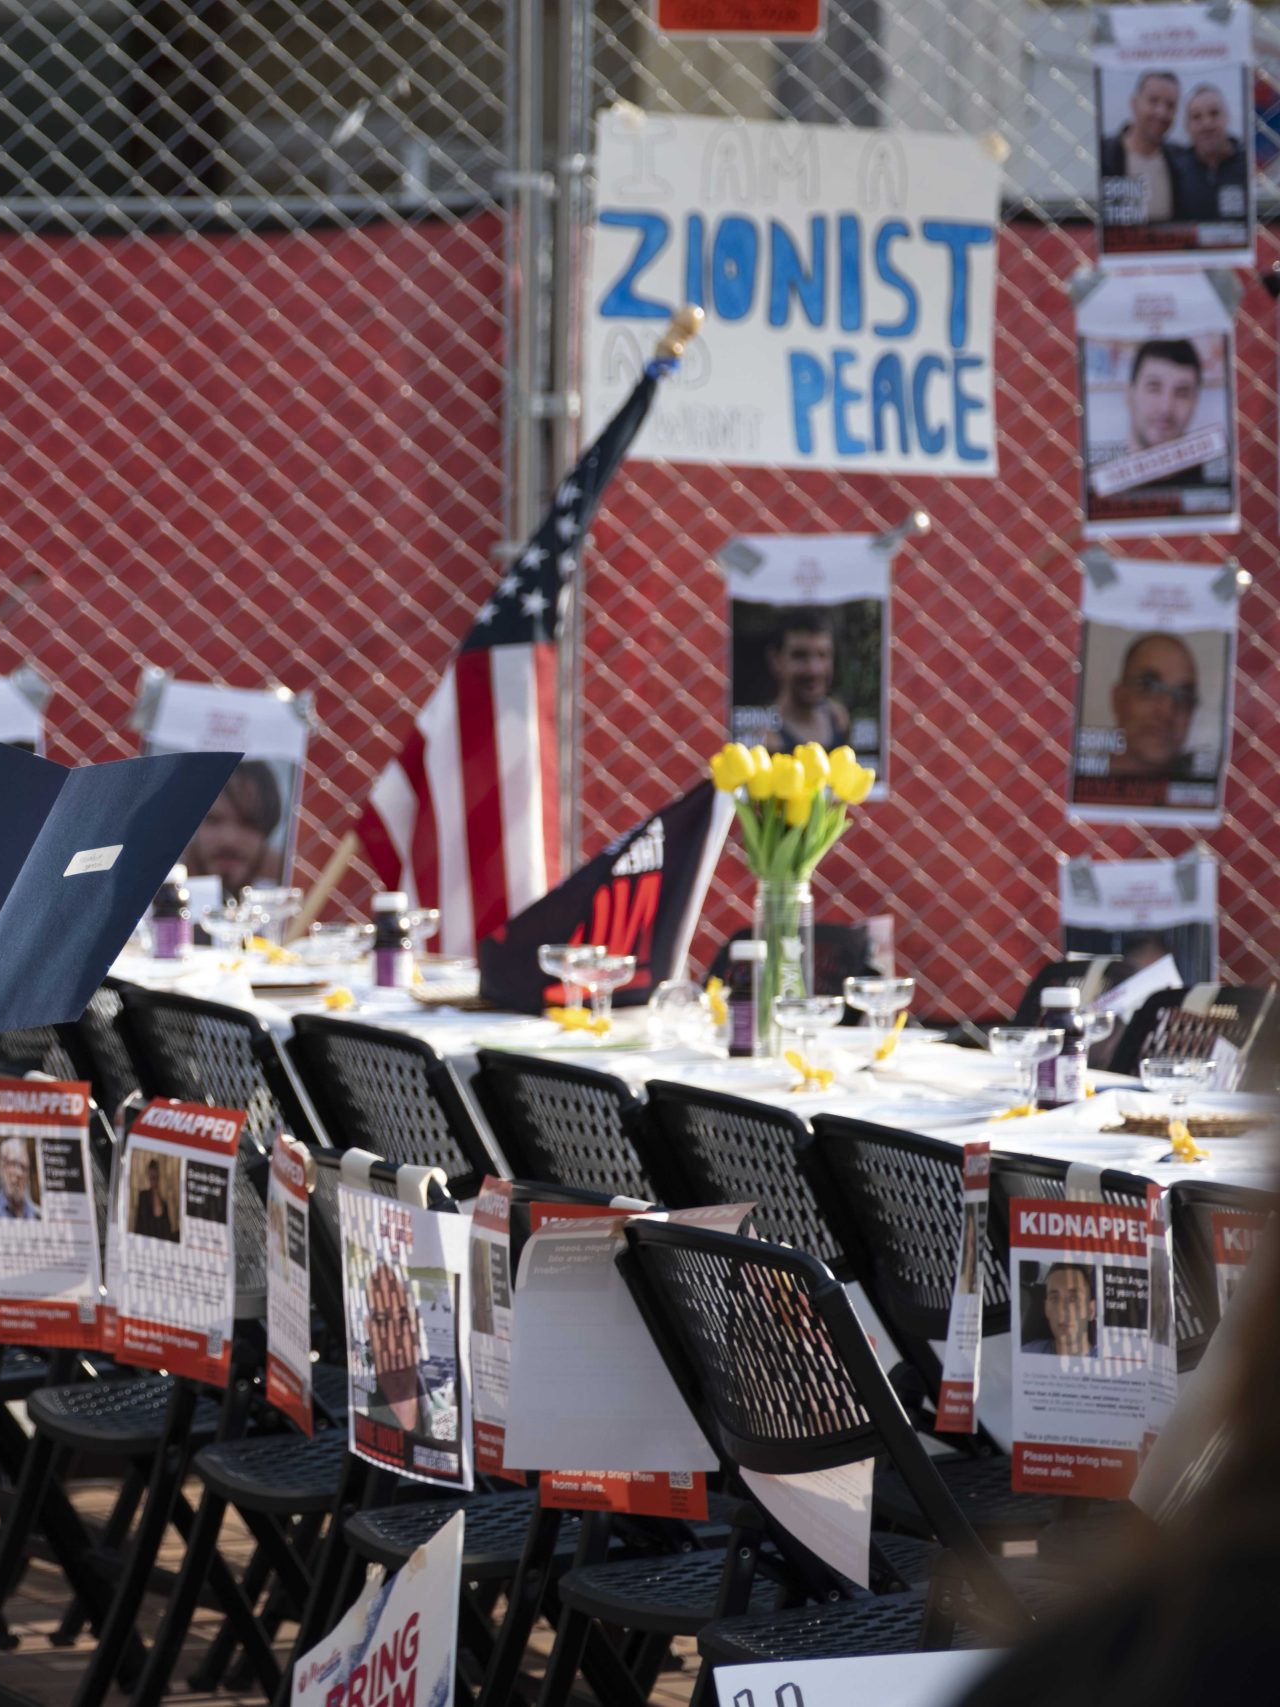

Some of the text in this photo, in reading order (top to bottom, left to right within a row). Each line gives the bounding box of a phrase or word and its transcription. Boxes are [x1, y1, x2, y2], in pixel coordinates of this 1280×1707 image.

[598, 210, 994, 349] ZIONIST
[788, 346, 989, 461] PEACE
[141, 1106, 237, 1143] KIDNAPPED
[1019, 1211, 1147, 1243] KIDNAPPED
[1023, 1450, 1122, 1468] Please help bring them
[1023, 1465, 1075, 1478] home alive.
[552, 1479, 606, 1493] home alive.
[632, 1471, 655, 1483] them
